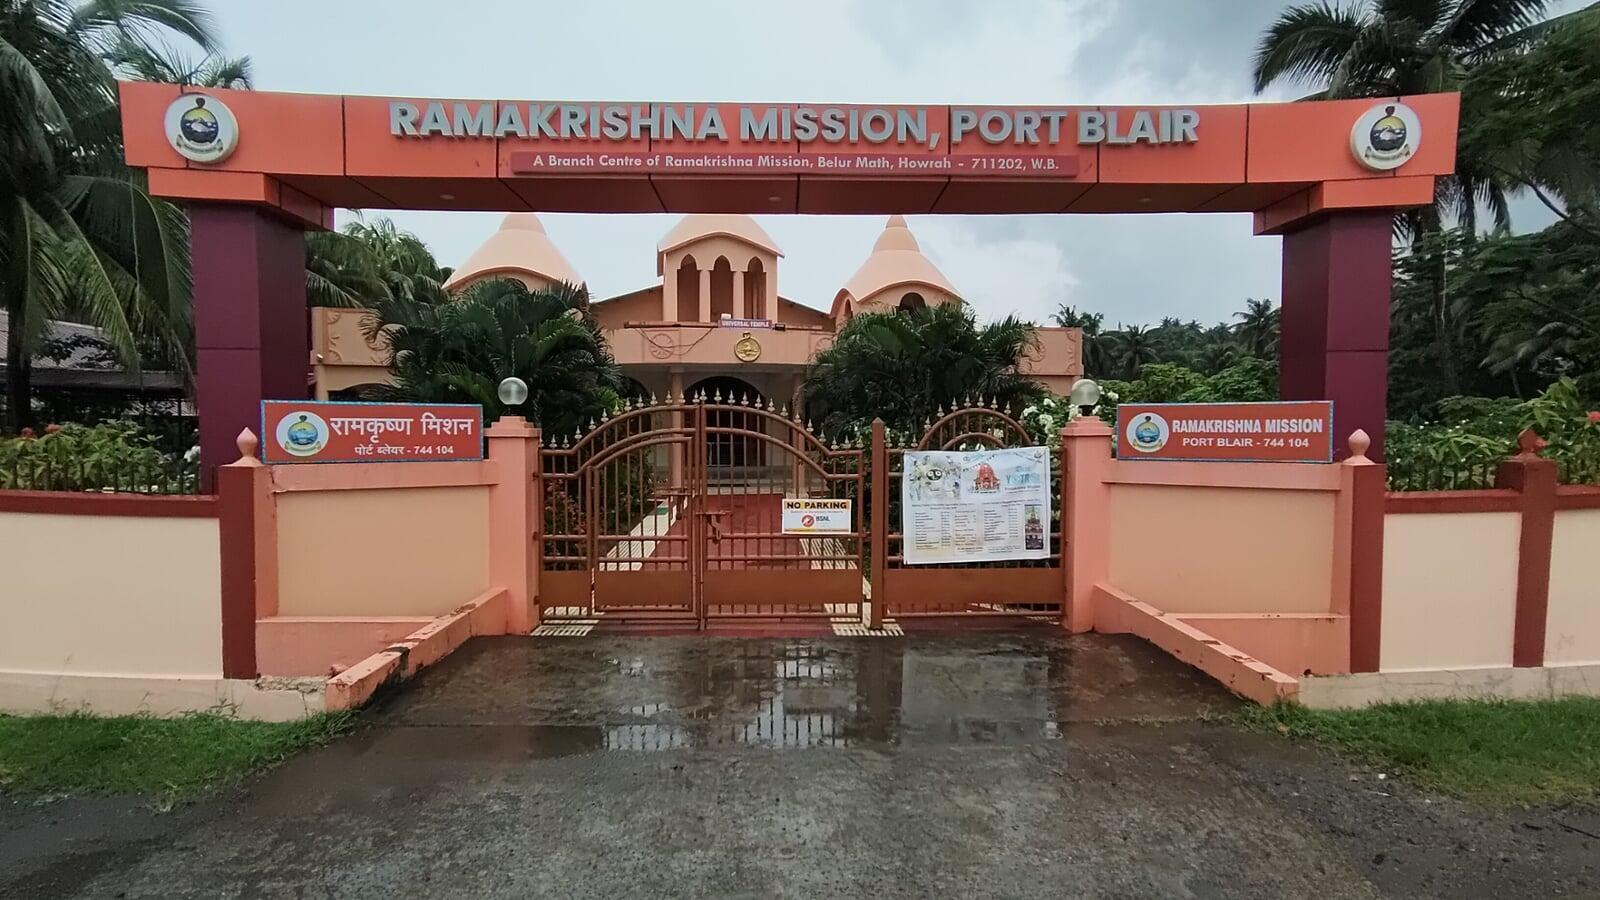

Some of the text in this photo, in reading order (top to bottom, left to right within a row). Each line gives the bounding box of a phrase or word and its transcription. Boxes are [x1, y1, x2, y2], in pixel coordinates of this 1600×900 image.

[389, 102, 1200, 150] RAMAKRISHNA MISSION, PORT BLAIR
[533, 155, 544, 166] A
[549, 155, 594, 167] Branch
[599, 155, 642, 167] Centre
[646, 155, 660, 167] of
[665, 156, 753, 168] Ramakrishna
[757, 157, 814, 169] Mission,
[818, 157, 851, 168] Belur
[855, 157, 894, 170] Math,
[898, 157, 951, 169] Howrah
[971, 158, 1026, 171] 711202,
[1031, 158, 1059, 170] W.B.
[330, 412, 474, 443] रामकृष्ण मिशन
[1172, 419, 1323, 433] RAMAKRISHNA MISSION
[355, 443, 373, 456] पोर्ट
[377, 444, 405, 455] ब्लेयर
[414, 446, 433, 455] 744
[436, 446, 454, 455] 104
[1183, 438, 1214, 447] PORT
[1217, 438, 1253, 447] BLAIR
[1264, 438, 1285, 448] 744
[1288, 438, 1309, 448] 104
